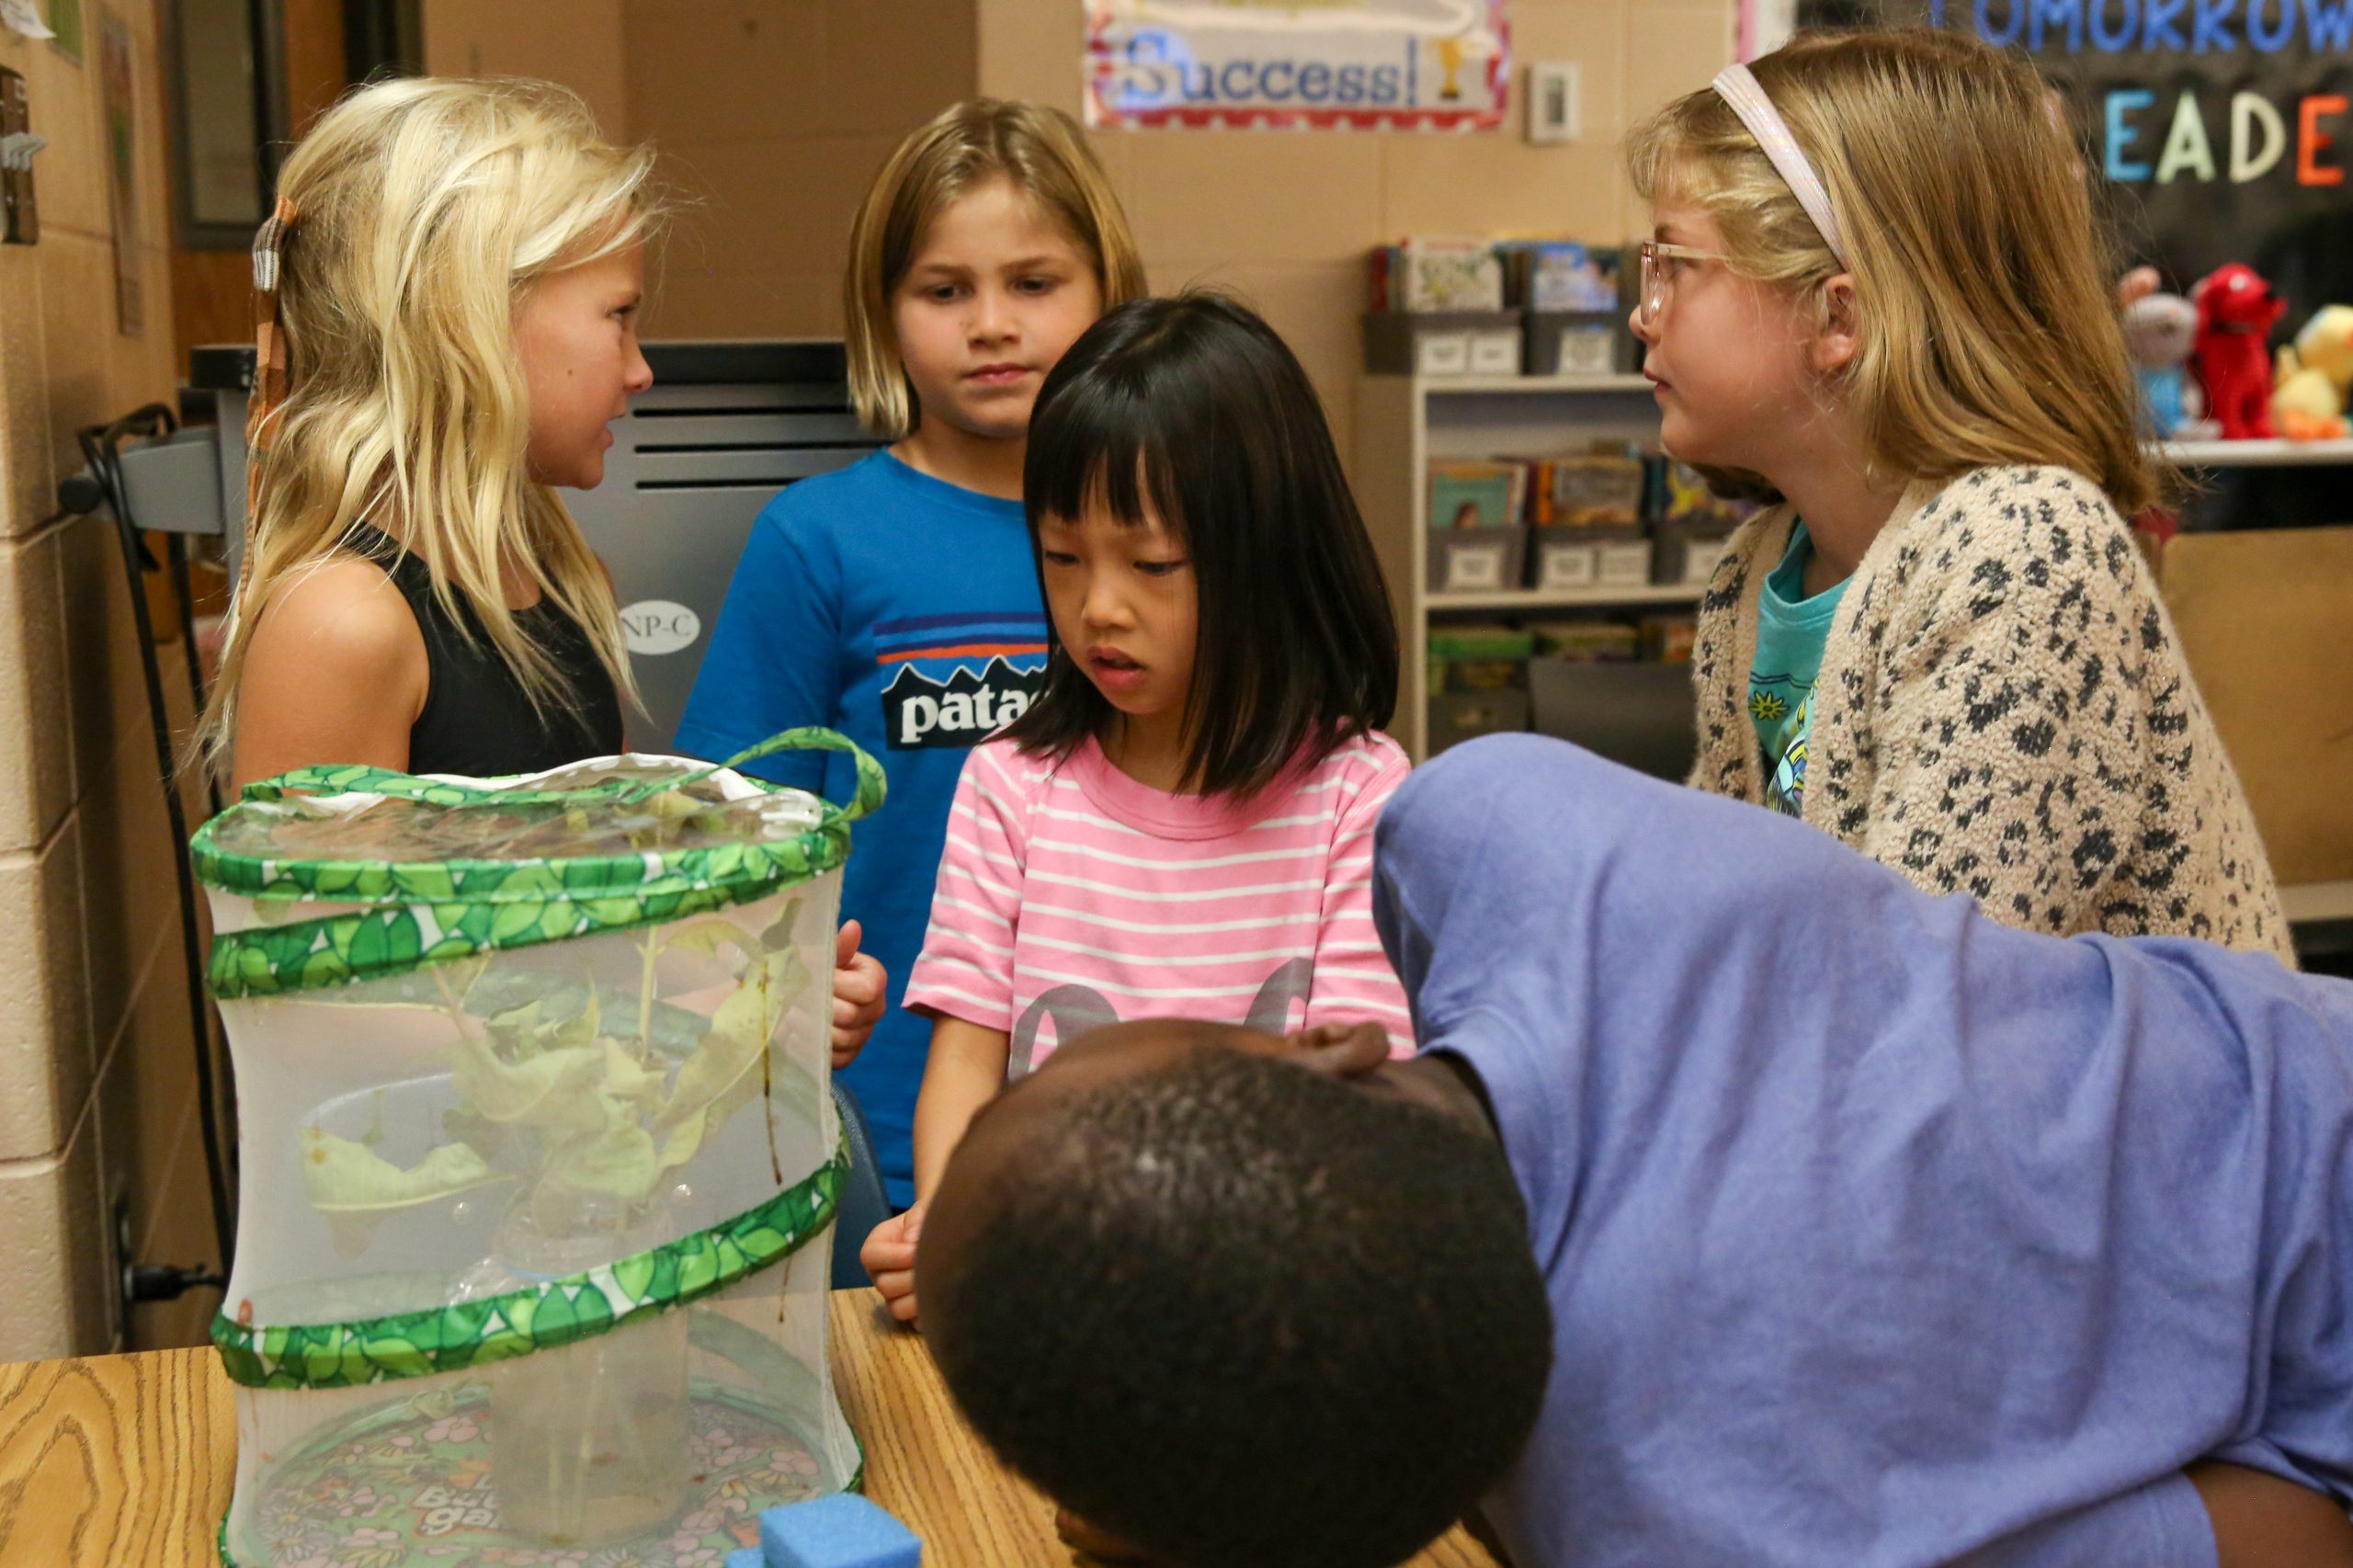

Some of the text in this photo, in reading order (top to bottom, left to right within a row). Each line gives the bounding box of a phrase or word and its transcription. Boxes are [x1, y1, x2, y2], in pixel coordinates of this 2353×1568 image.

[1930, 0, 2353, 52] OMORROW
[1123, 31, 1418, 105] Success!
[2042, 89, 2350, 187] EADE
[900, 683, 1044, 744] pata
[421, 1506, 502, 1536] ga
